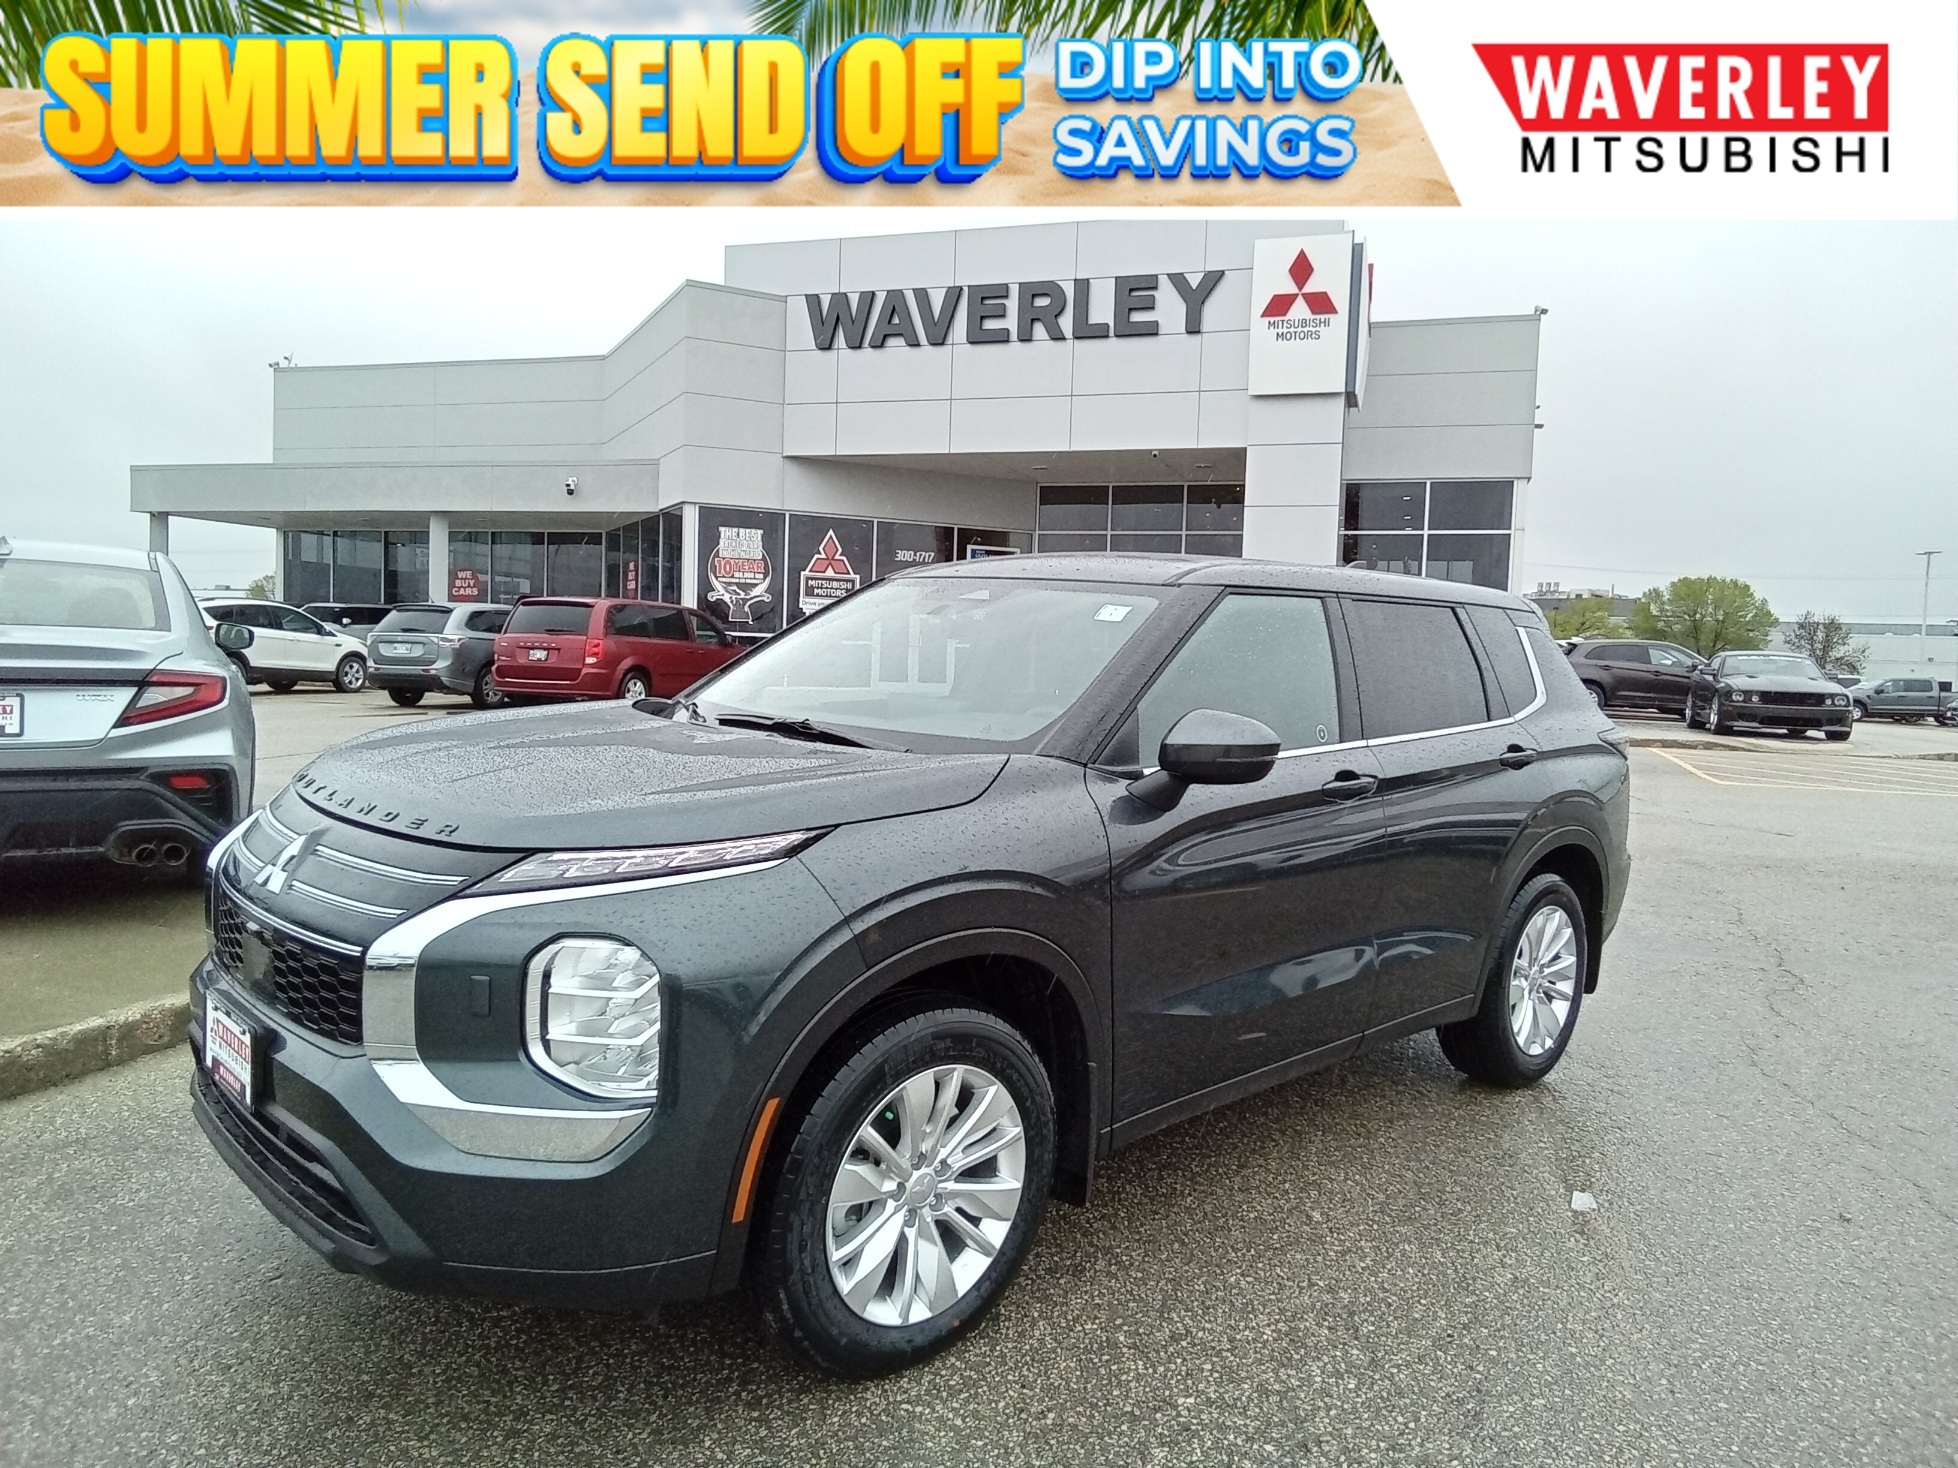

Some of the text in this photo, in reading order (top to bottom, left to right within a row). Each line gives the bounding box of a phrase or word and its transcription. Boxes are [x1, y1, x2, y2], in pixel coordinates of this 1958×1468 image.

[804, 270, 1225, 350] WAVERLEY
[1267, 317, 1331, 331] MITSUBISHI
[1275, 329, 1321, 342] MOTORS
[719, 527, 763, 541] THE BEST
[894, 550, 935, 563] 300-1717
[715, 558, 764, 577] 10 YEAR
[455, 579, 475, 587] BUY
[808, 579, 853, 590] MITSUBISHI
[452, 587, 479, 596] CARS
[814, 588, 847, 597] MOTORS
